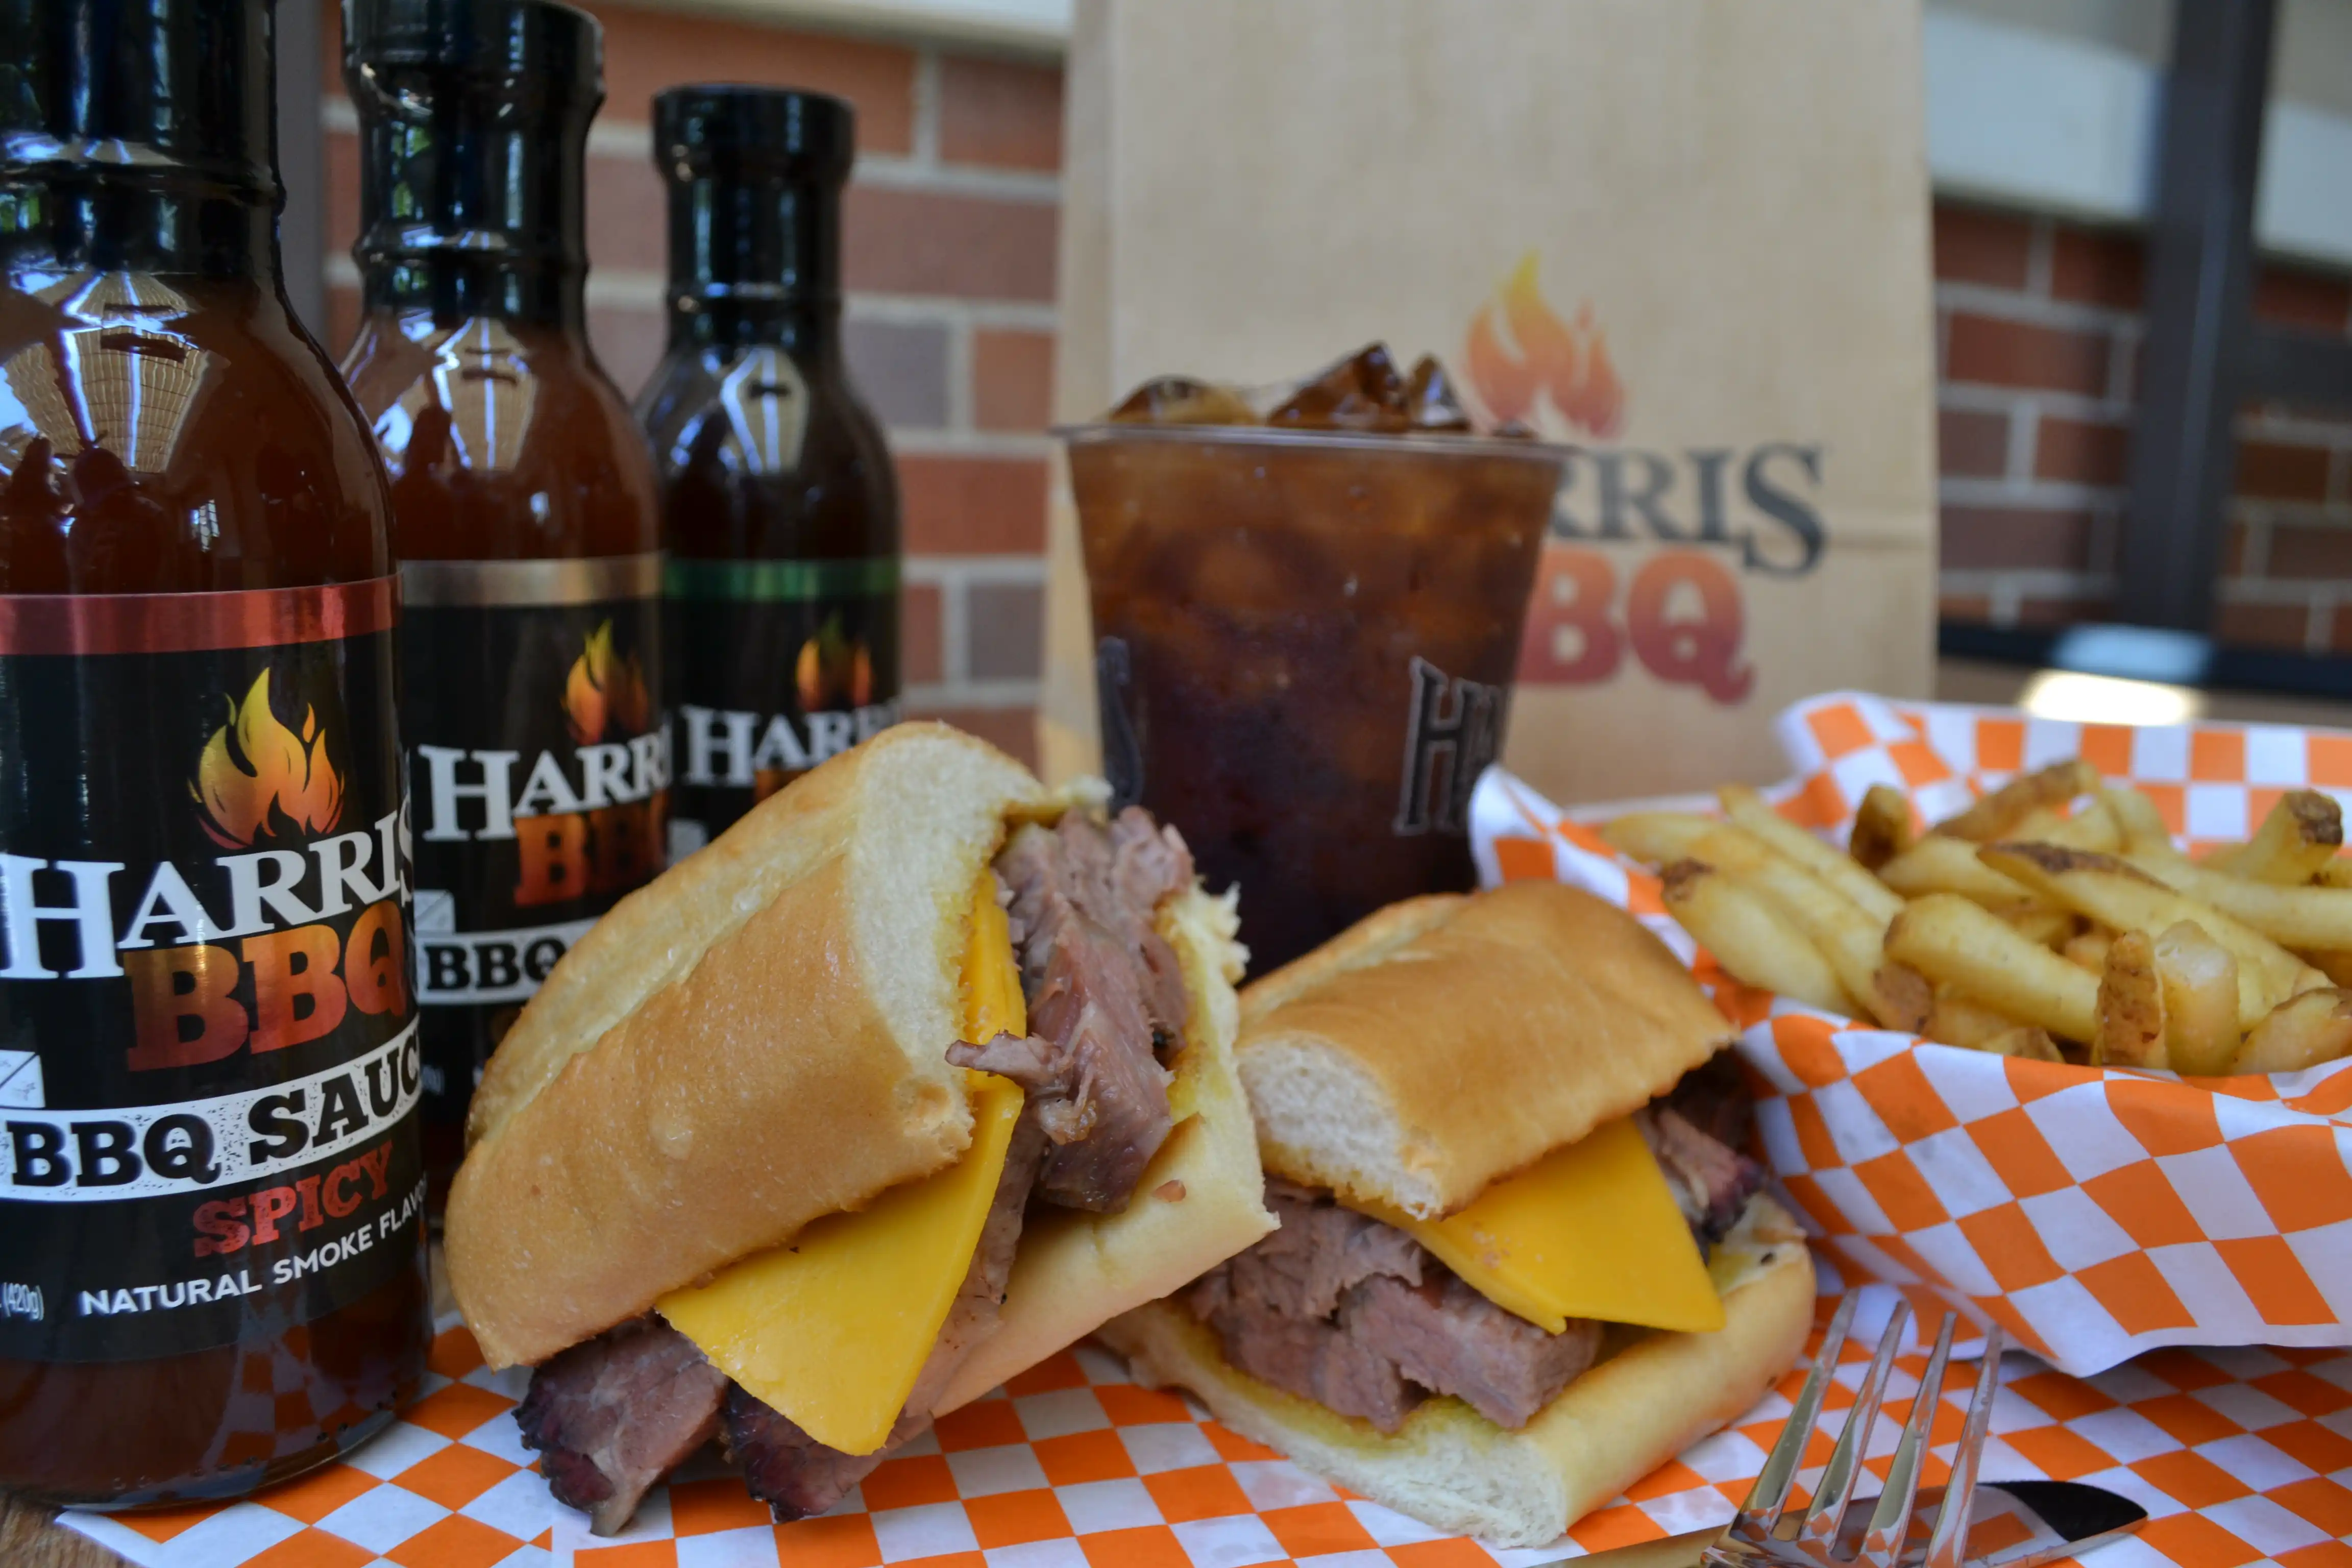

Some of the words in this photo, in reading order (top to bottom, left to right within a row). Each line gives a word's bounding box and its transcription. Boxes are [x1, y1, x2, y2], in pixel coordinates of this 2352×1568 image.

[1551, 440, 1830, 581] RIS
[418, 719, 673, 841] HARR
[124, 900, 407, 1071] BBQ
[5, 1113, 222, 1187] BBQ
[248, 1032, 418, 1166] SAUC
[79, 1270, 262, 1316] NATURAL
[273, 1224, 373, 1284] SMOKE
[379, 1171, 428, 1239] FLAVO
[193, 1140, 394, 1258] SPICY
